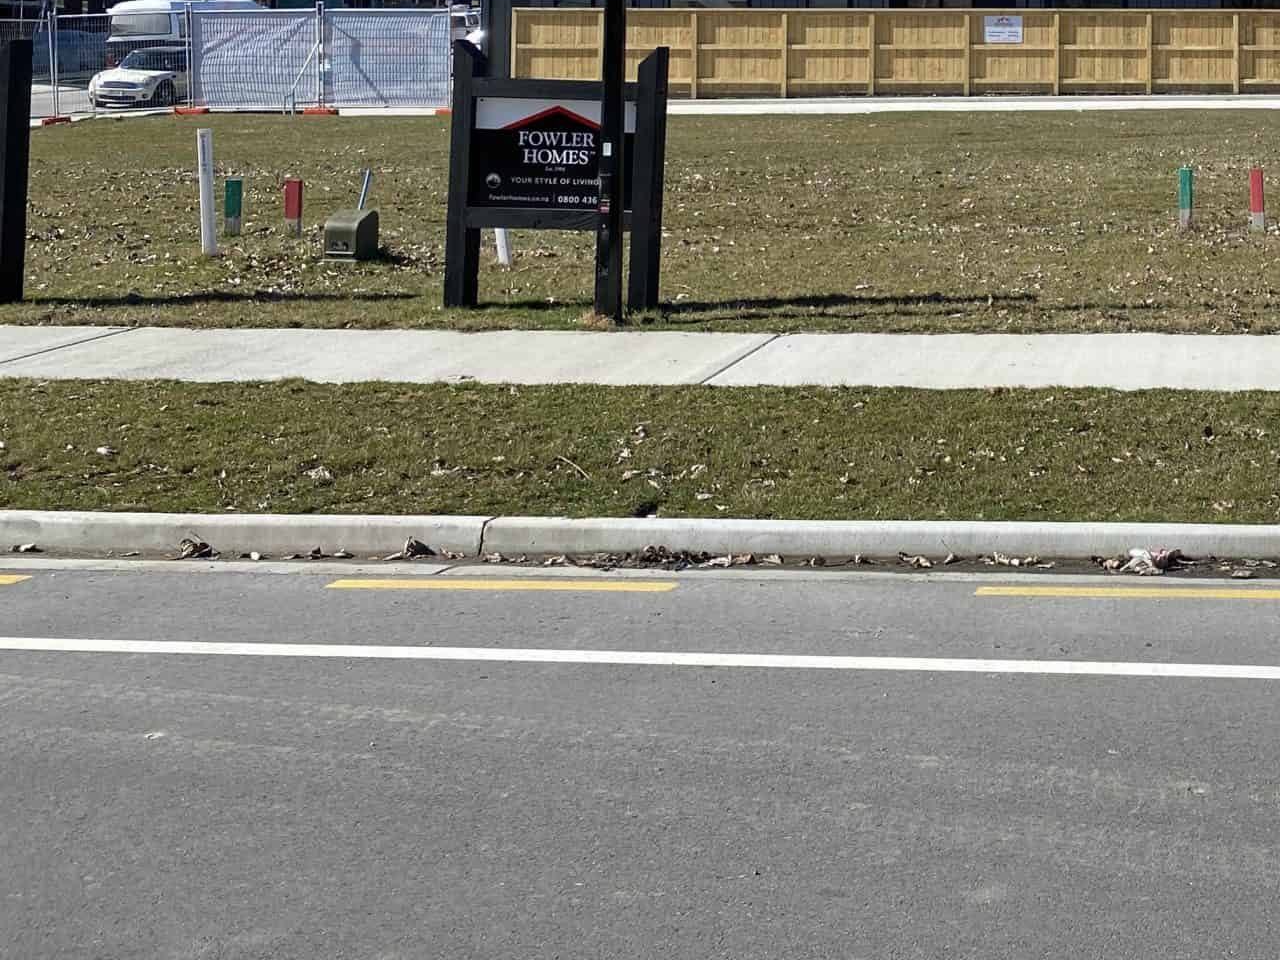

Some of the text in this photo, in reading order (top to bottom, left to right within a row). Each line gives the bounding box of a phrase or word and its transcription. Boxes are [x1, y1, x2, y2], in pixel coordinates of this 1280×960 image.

[518, 130, 596, 147] FOWLER
[523, 148, 590, 165] HOMES
[511, 176, 533, 184] YOUR
[534, 177, 557, 185] STYLE
[572, 178, 600, 186] LIVING
[557, 195, 598, 204] 0800 436
